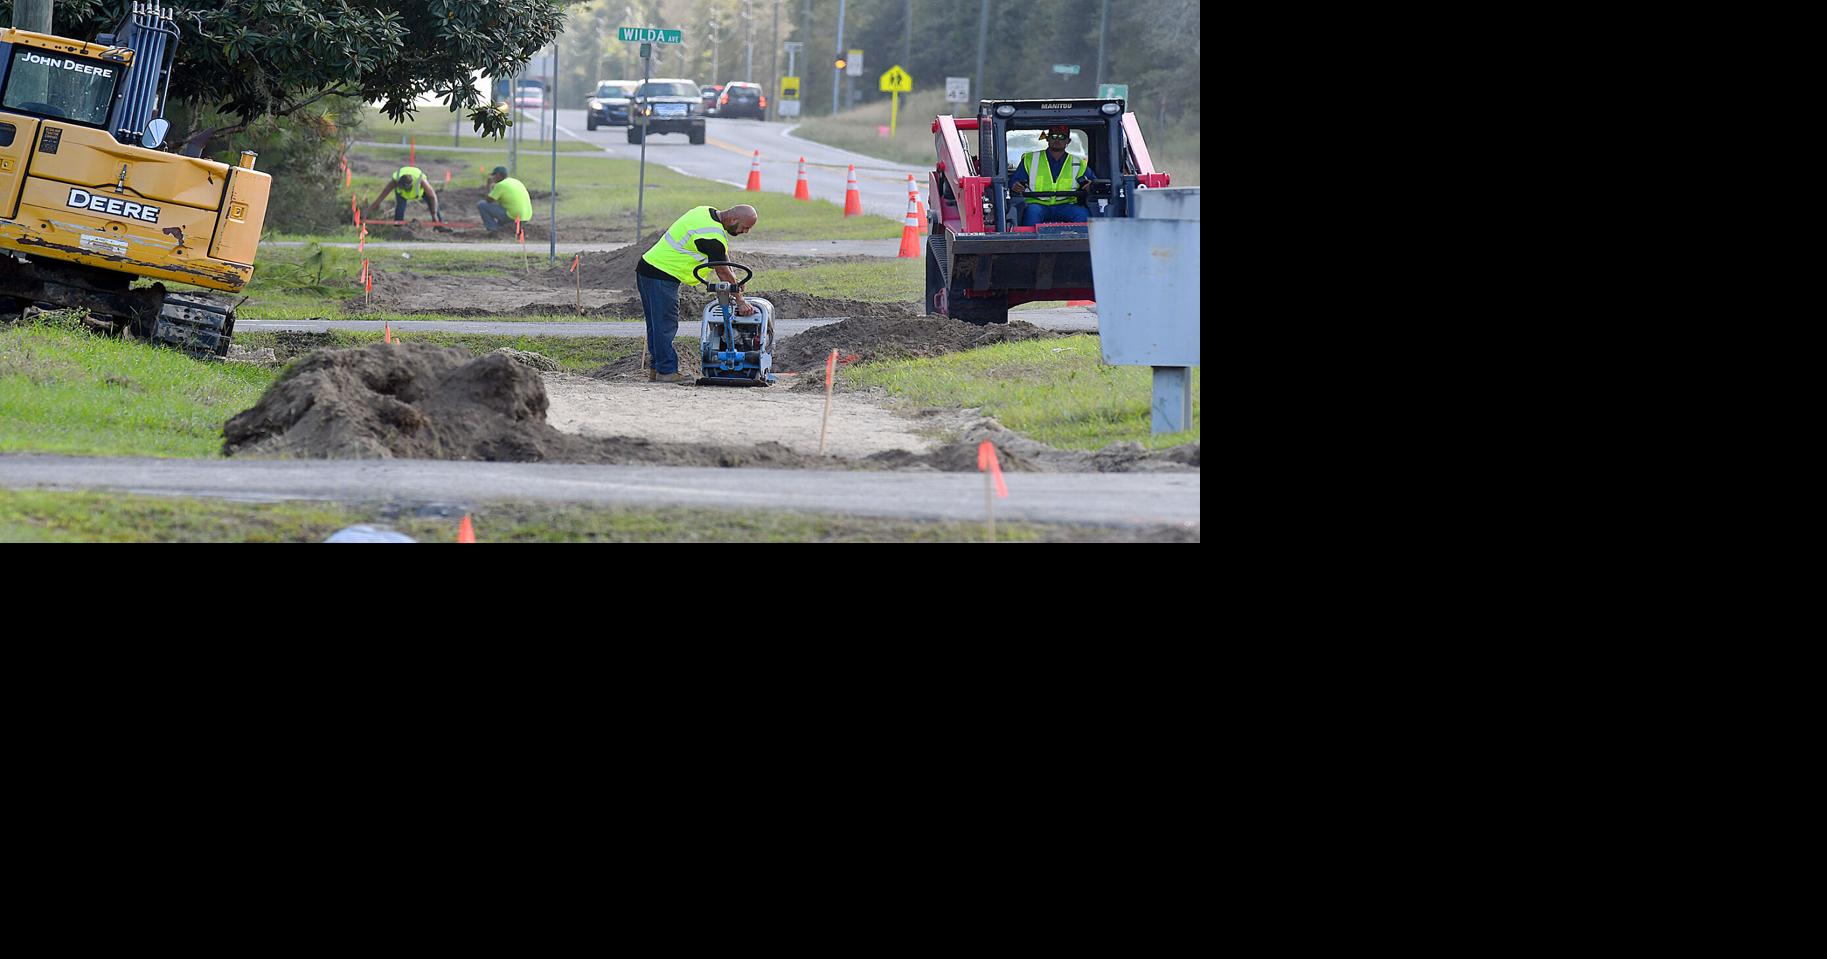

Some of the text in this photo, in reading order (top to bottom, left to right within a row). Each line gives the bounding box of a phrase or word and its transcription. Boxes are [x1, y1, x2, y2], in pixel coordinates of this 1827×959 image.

[623, 28, 679, 43] WILDA AVE
[21, 52, 113, 78] JOHN DEERE
[68, 188, 160, 222] DEERE
